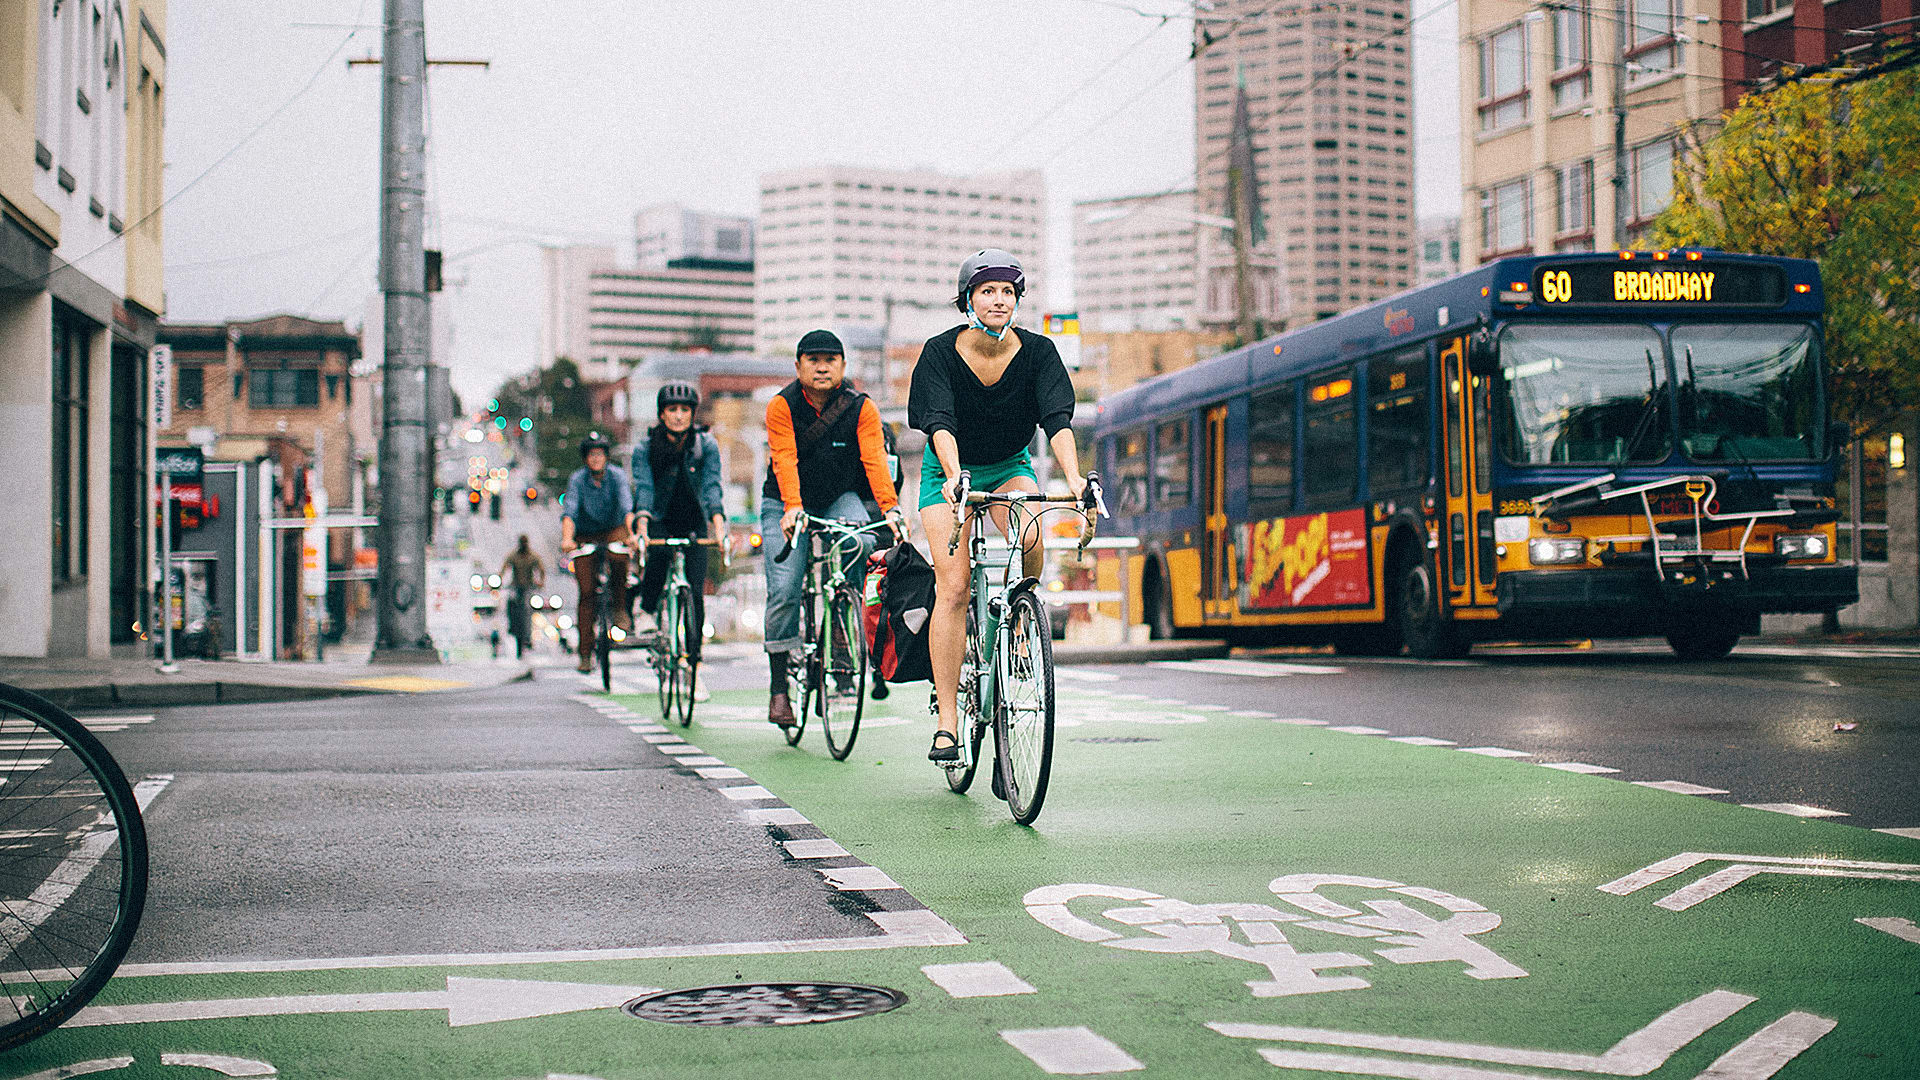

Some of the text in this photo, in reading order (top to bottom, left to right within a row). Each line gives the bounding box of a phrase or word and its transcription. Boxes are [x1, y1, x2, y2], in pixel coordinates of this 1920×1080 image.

[1542, 270, 1715, 303] 60 BROADWAY
[1660, 499, 1720, 515] METO
